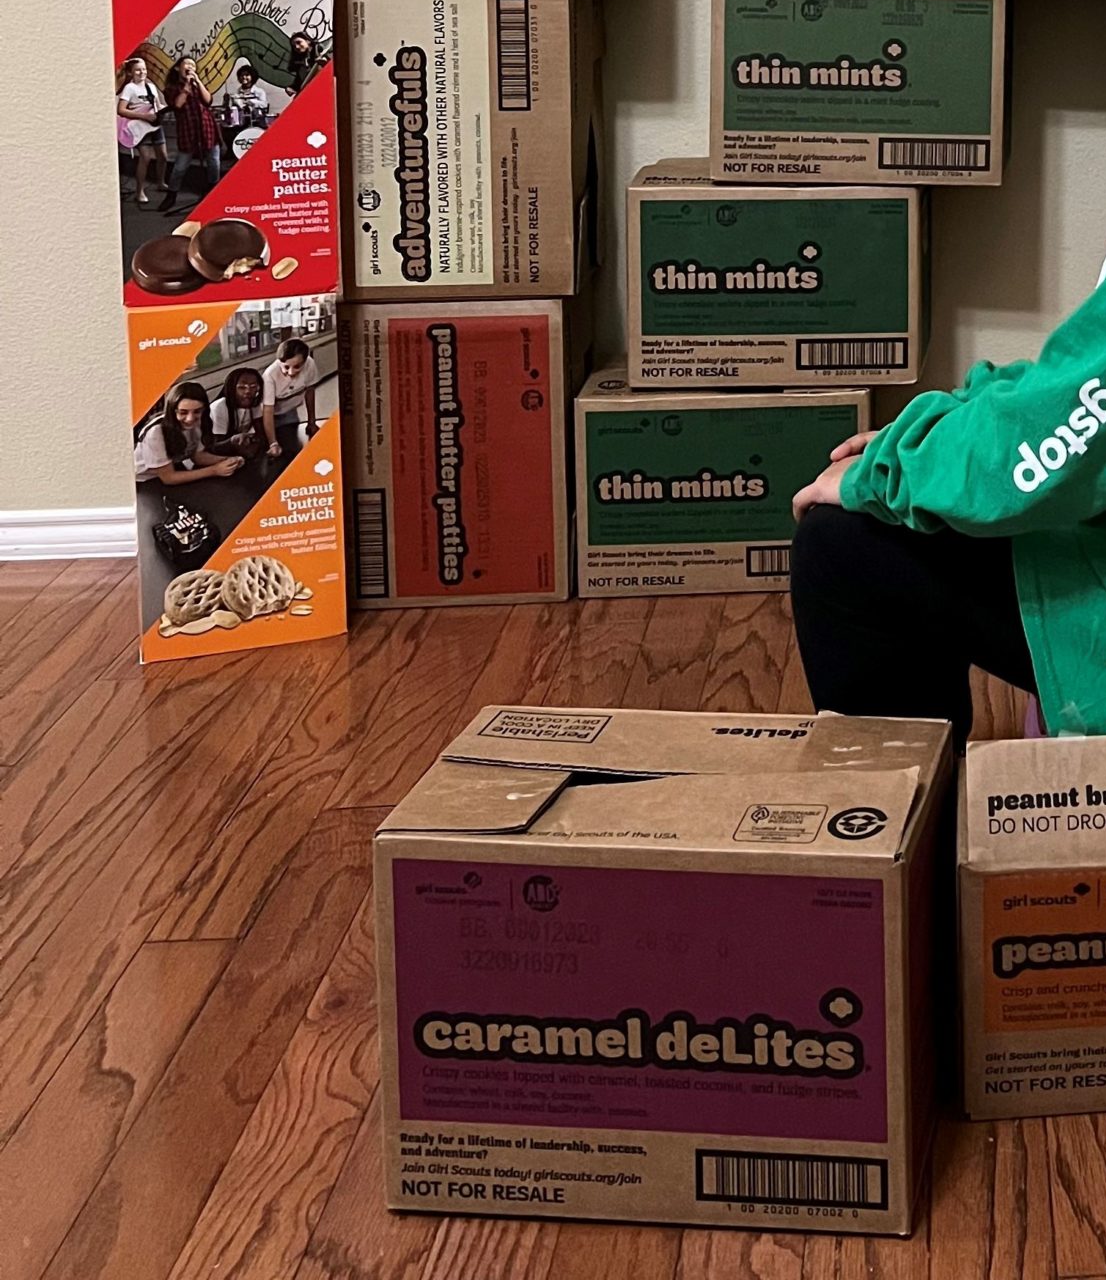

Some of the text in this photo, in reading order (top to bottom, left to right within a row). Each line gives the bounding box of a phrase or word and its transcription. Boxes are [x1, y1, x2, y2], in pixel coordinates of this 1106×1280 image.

[737, 58, 902, 87] thin mints
[433, 0, 450, 273] NATURALLY FLAVORED WITH OTHER NATURAL FLAVORS
[272, 155, 327, 172] peanut
[395, 51, 427, 277] adventurefuls
[279, 169, 328, 182] butter
[652, 263, 819, 291] thin mints
[139, 335, 192, 350] girl scouts
[432, 328, 465, 581] peanut butter patties
[280, 481, 334, 501] peanut
[598, 472, 766, 501] thin mints
[287, 496, 335, 511] butter
[259, 507, 335, 528] sandwich
[492, 724, 592, 740] Perishable
[987, 787, 1080, 817] peanut
[988, 818, 1016, 835] DO
[1022, 816, 1061, 833] NOT
[1003, 894, 1077, 910] girl scouts
[421, 1017, 856, 1071] caramel deLites
[985, 1079, 1024, 1095] NOT
[1029, 1076, 1067, 1092] FOR
[402, 1163, 643, 1186] Join Girl Scouts today! girlscouts.org/join
[401, 1180, 566, 1204] NOT FOR RESALE
